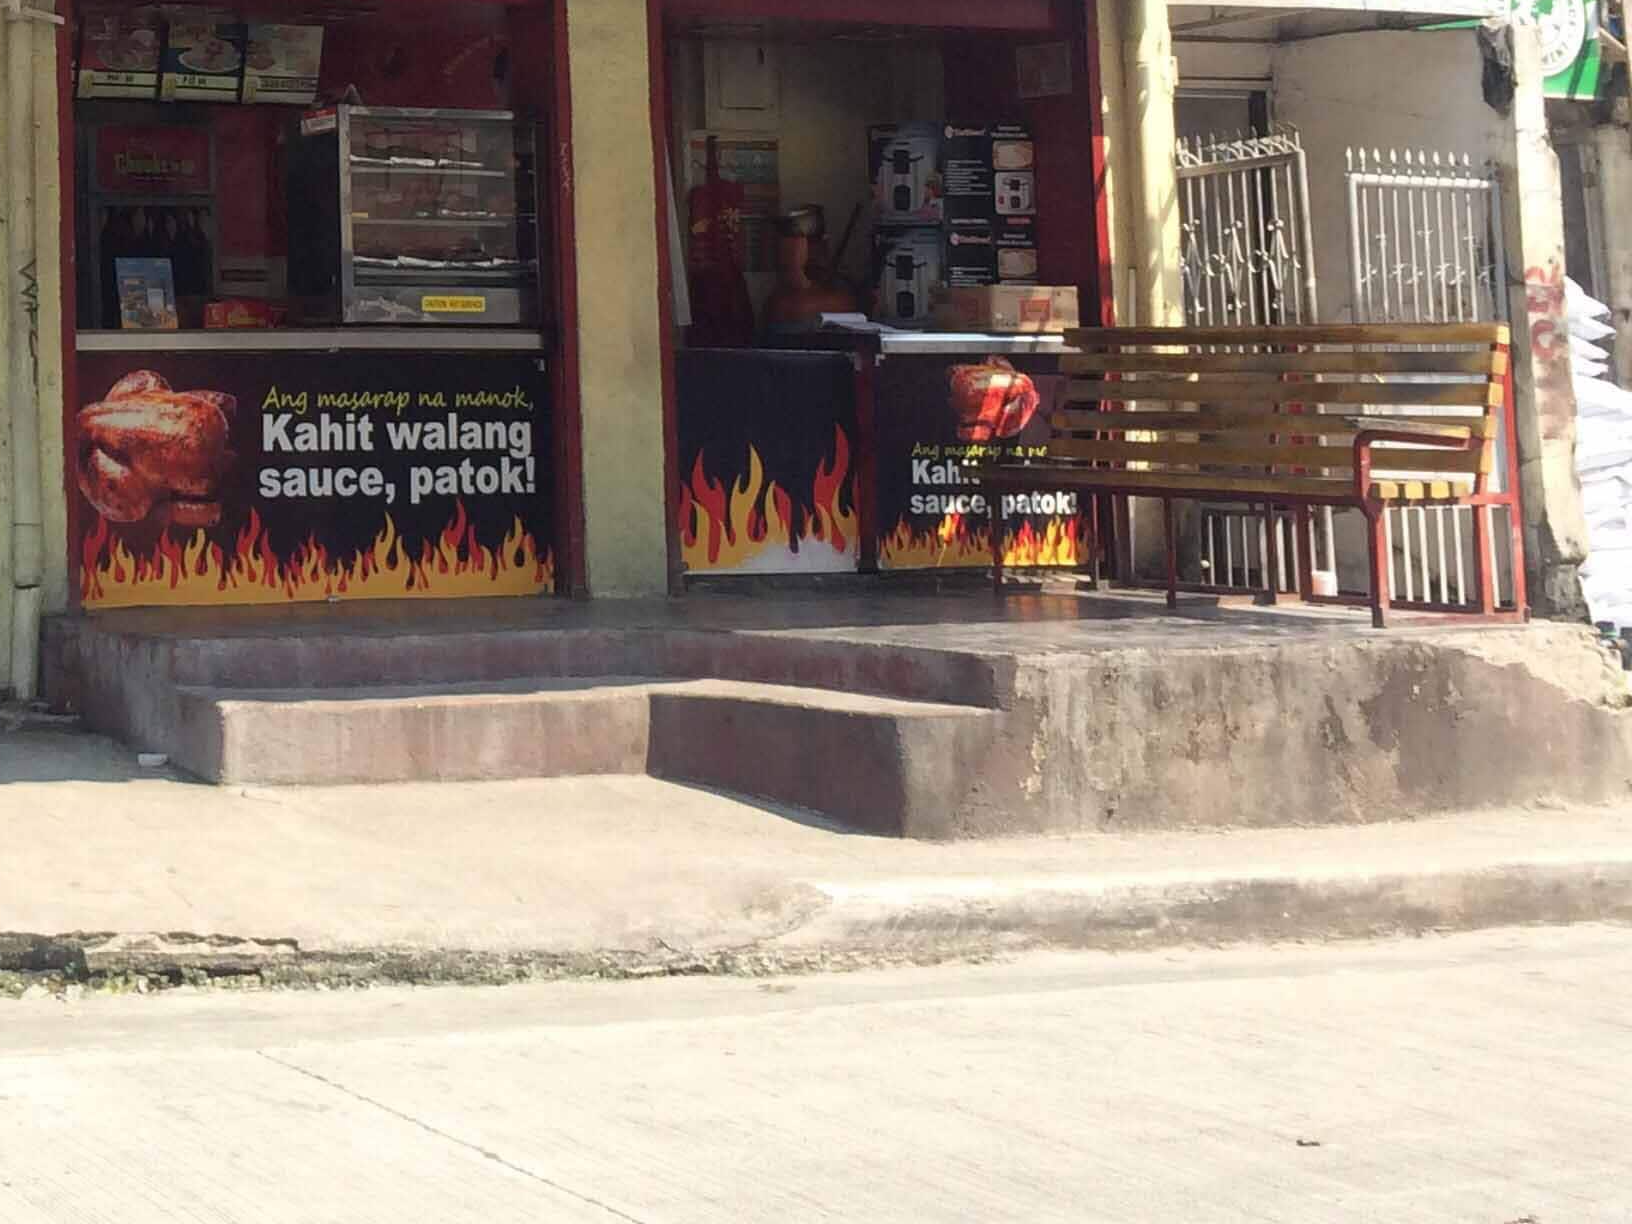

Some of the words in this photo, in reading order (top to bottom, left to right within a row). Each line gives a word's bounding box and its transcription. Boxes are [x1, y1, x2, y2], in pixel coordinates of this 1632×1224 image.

[262, 386, 308, 414] Ang
[317, 392, 410, 416] masarap
[418, 392, 447, 408] na
[262, 413, 373, 452] Kahit
[387, 412, 531, 458] walang
[912, 442, 939, 460] Ang
[259, 466, 396, 504] sauce,
[410, 457, 536, 504] patok!
[910, 493, 992, 519] sauce,
[1001, 490, 1078, 520] patok!
